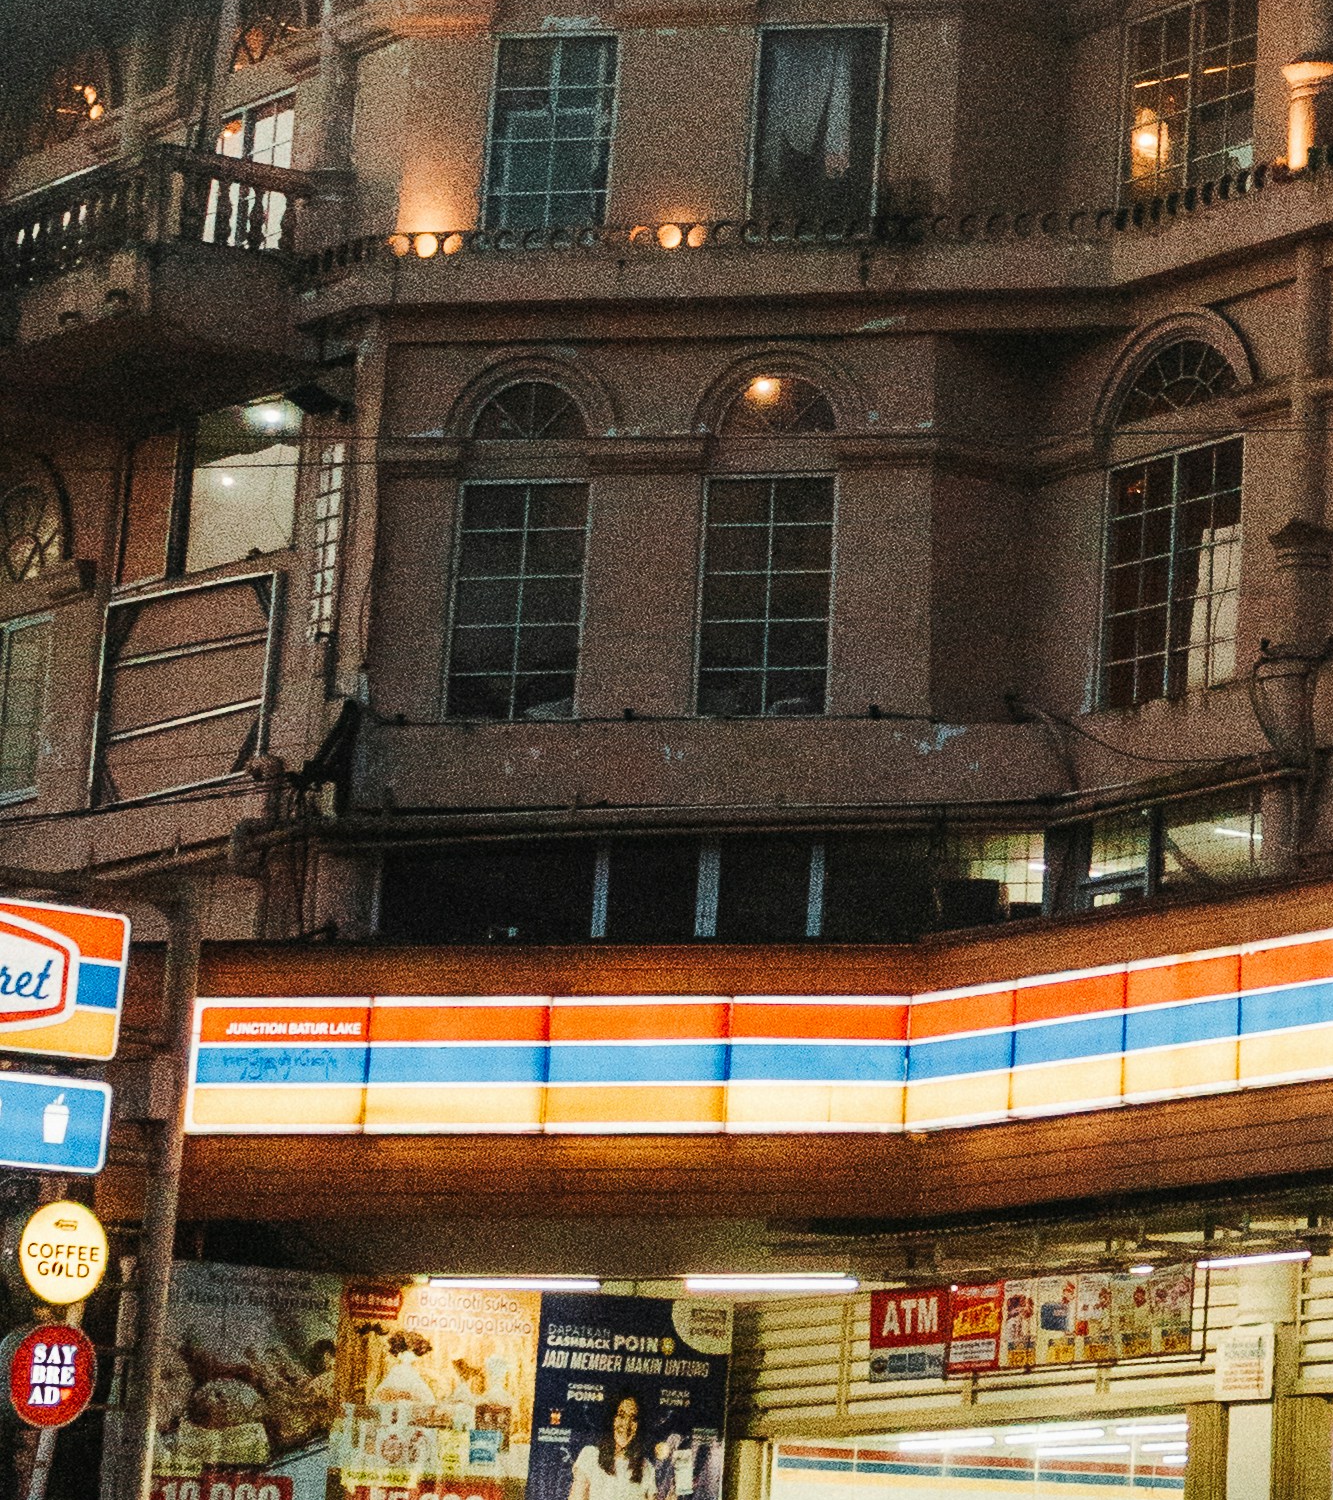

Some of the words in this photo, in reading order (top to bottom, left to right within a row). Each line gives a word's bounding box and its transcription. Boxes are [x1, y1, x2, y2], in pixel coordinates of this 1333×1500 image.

[225, 1022, 287, 1036] JUNCTION
[288, 1022, 328, 1036] BATUR
[329, 1022, 362, 1036] LAKE
[27, 1242, 100, 1263] COFFEE
[37, 1261, 90, 1279] GOLD
[881, 1296, 939, 1338] ATM
[33, 1342, 78, 1366] SAY
[546, 1334, 611, 1351] CASHBACK
[612, 1334, 660, 1354] POIN
[541, 1349, 570, 1370] JADI
[570, 1351, 623, 1374] MEMBER
[624, 1355, 663, 1376] MAKIN
[663, 1358, 711, 1379] UNTUNG
[30, 1364, 76, 1386] BRE
[28, 1386, 61, 1406] AD
